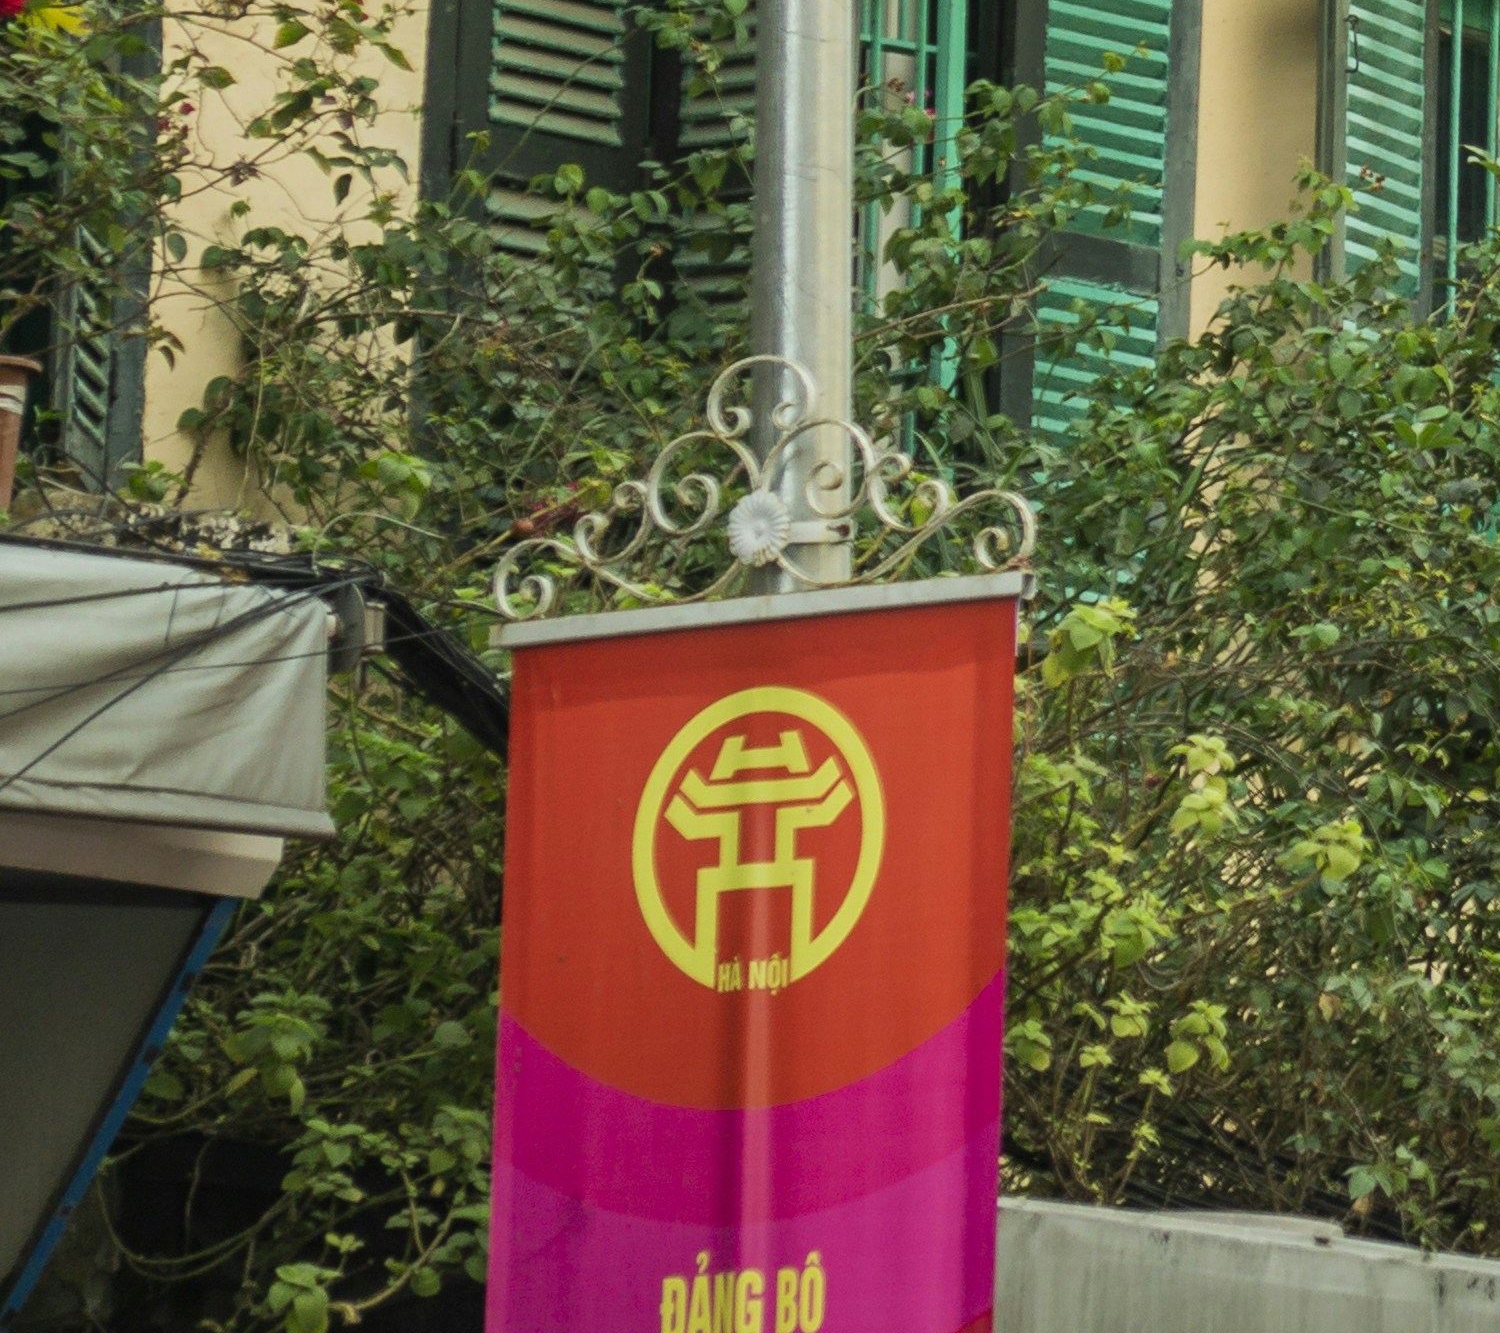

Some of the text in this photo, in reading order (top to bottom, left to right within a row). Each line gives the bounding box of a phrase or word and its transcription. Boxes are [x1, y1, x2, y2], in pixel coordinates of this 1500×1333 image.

[718, 952, 789, 996] HÀ NỘI
[660, 1250, 764, 1333] ĐẢNG
